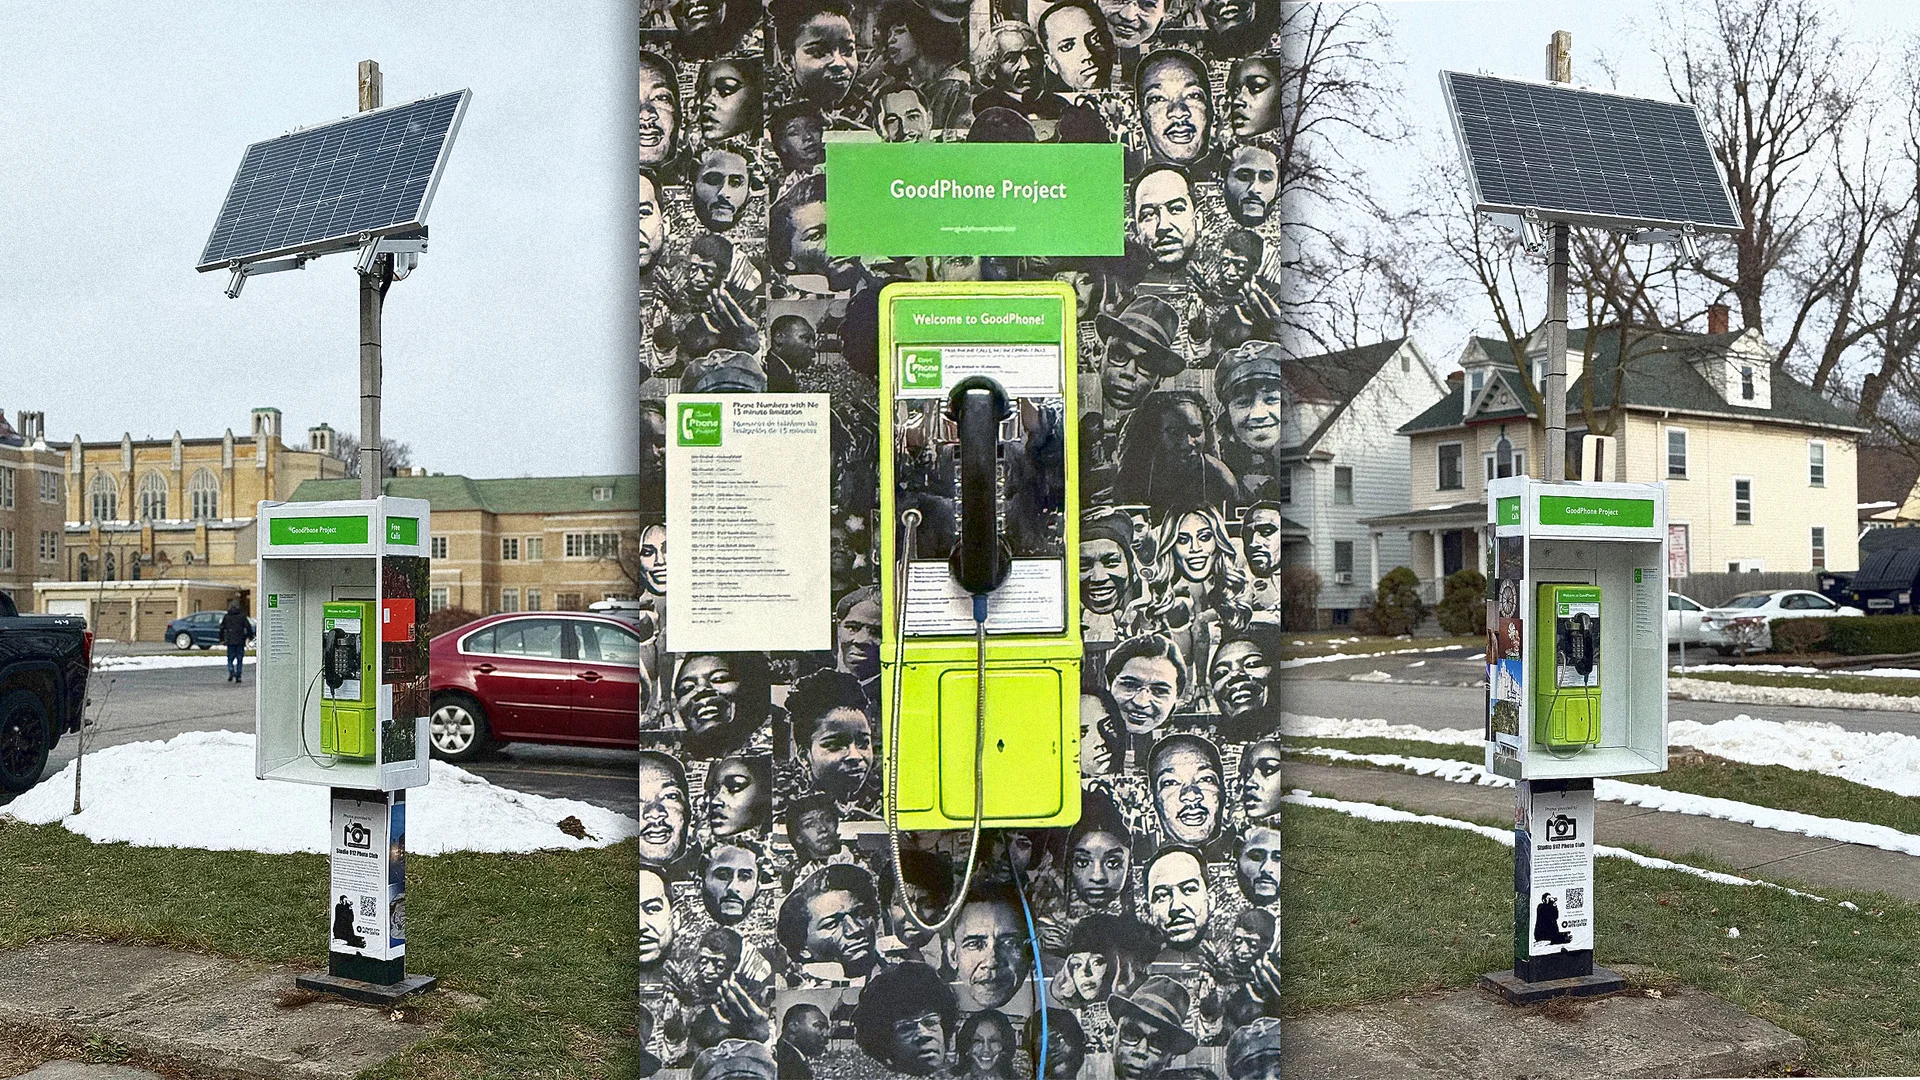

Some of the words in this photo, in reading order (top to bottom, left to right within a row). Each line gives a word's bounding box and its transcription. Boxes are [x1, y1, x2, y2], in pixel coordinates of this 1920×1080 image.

[890, 179, 995, 199] GoodPhone
[1002, 179, 1067, 203] Project
[913, 313, 962, 325] Welcome
[965, 314, 977, 325] to
[981, 312, 1045, 325] GoodPhone!
[911, 363, 939, 373] Phone
[689, 419, 718, 427] Phone
[1565, 506, 1597, 515] GoodPhone
[1598, 507, 1619, 517] Project
[291, 526, 319, 534] GoodPhone
[319, 526, 337, 535] Project
[391, 523, 400, 531] Free
[390, 531, 401, 540] Calls
[336, 848, 349, 856] Studio
[356, 850, 369, 858] Photo
